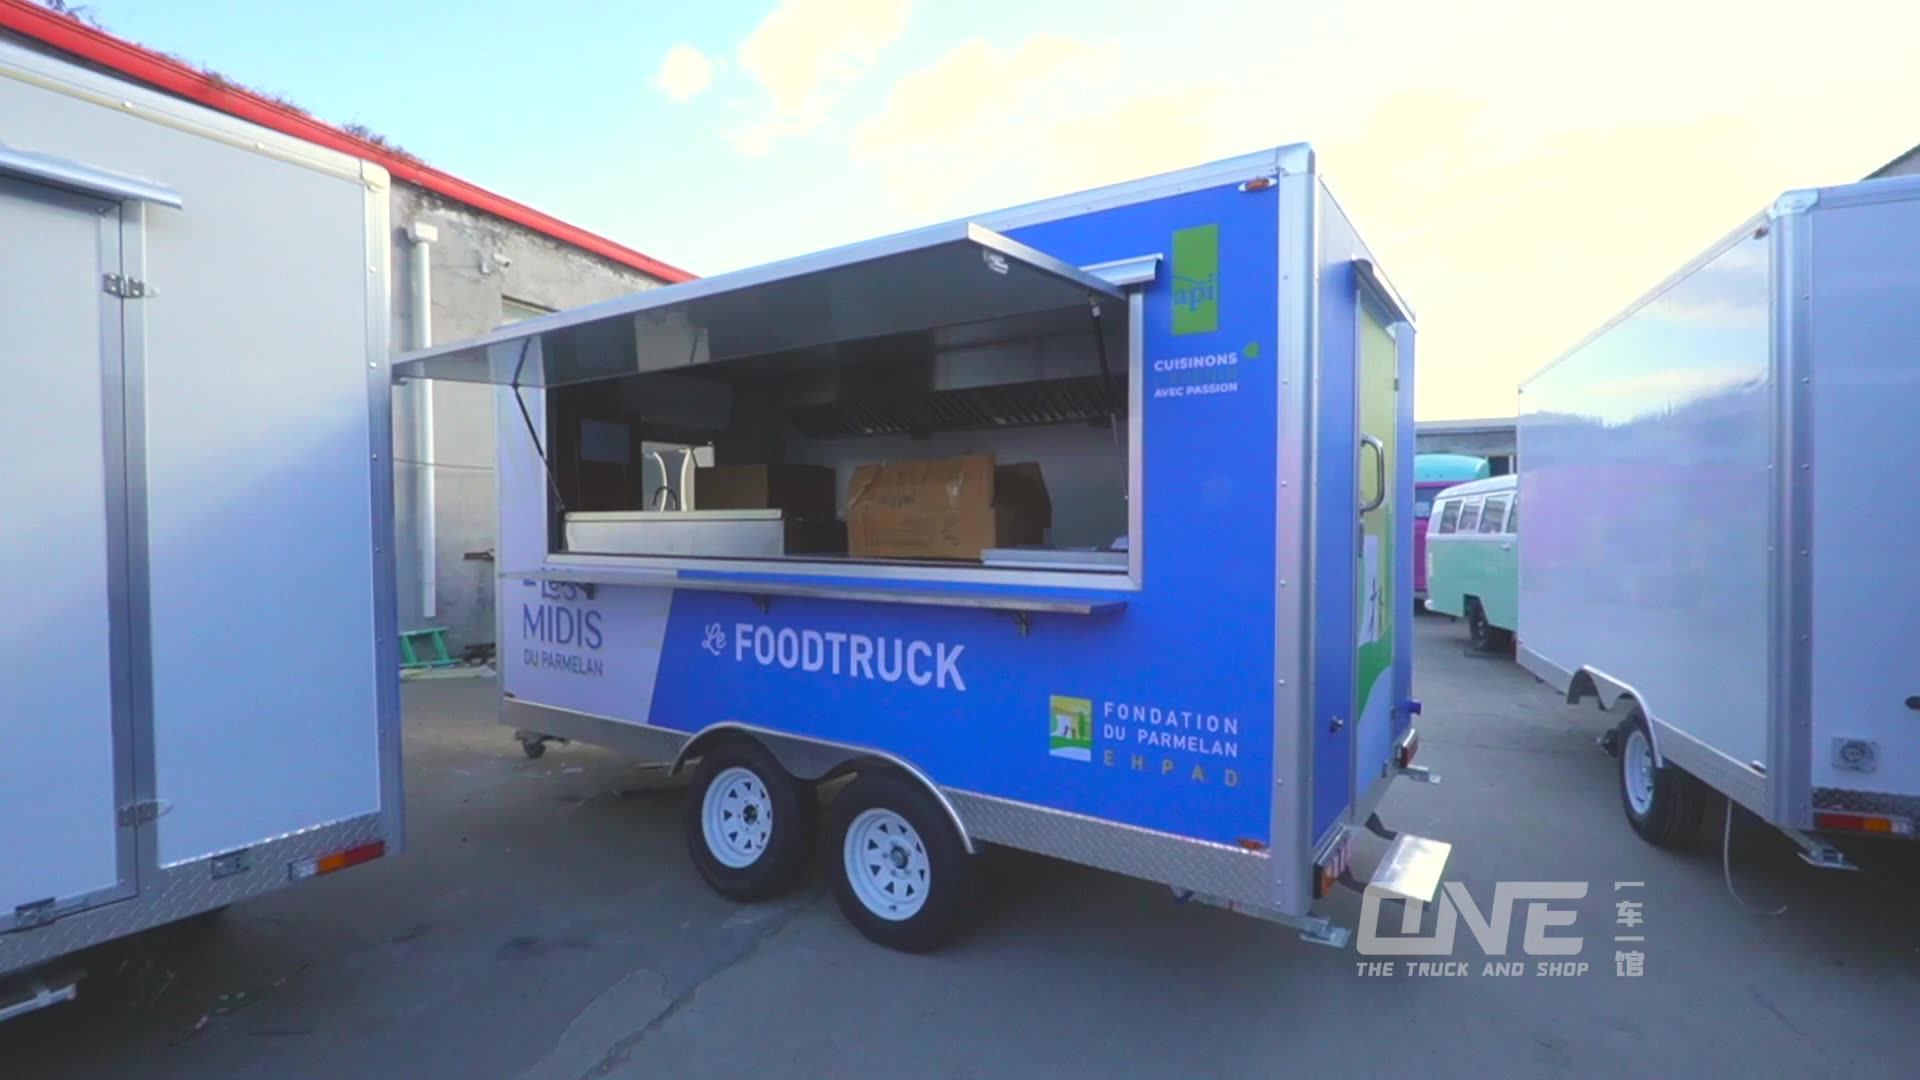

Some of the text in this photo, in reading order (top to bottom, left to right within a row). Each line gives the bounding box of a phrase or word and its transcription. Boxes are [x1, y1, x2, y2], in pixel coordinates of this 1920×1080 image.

[1174, 273, 1214, 312] api
[1154, 352, 1238, 372] CUISINONS
[1154, 382, 1238, 398] AVEC PASSION
[523, 604, 603, 650] MIDIS
[523, 649, 603, 676] DU PARMELAN
[701, 622, 966, 691] Le FOODTRUCK
[1104, 702, 1238, 735] FONDATION
[1103, 724, 1238, 757] DU PARMELAN
